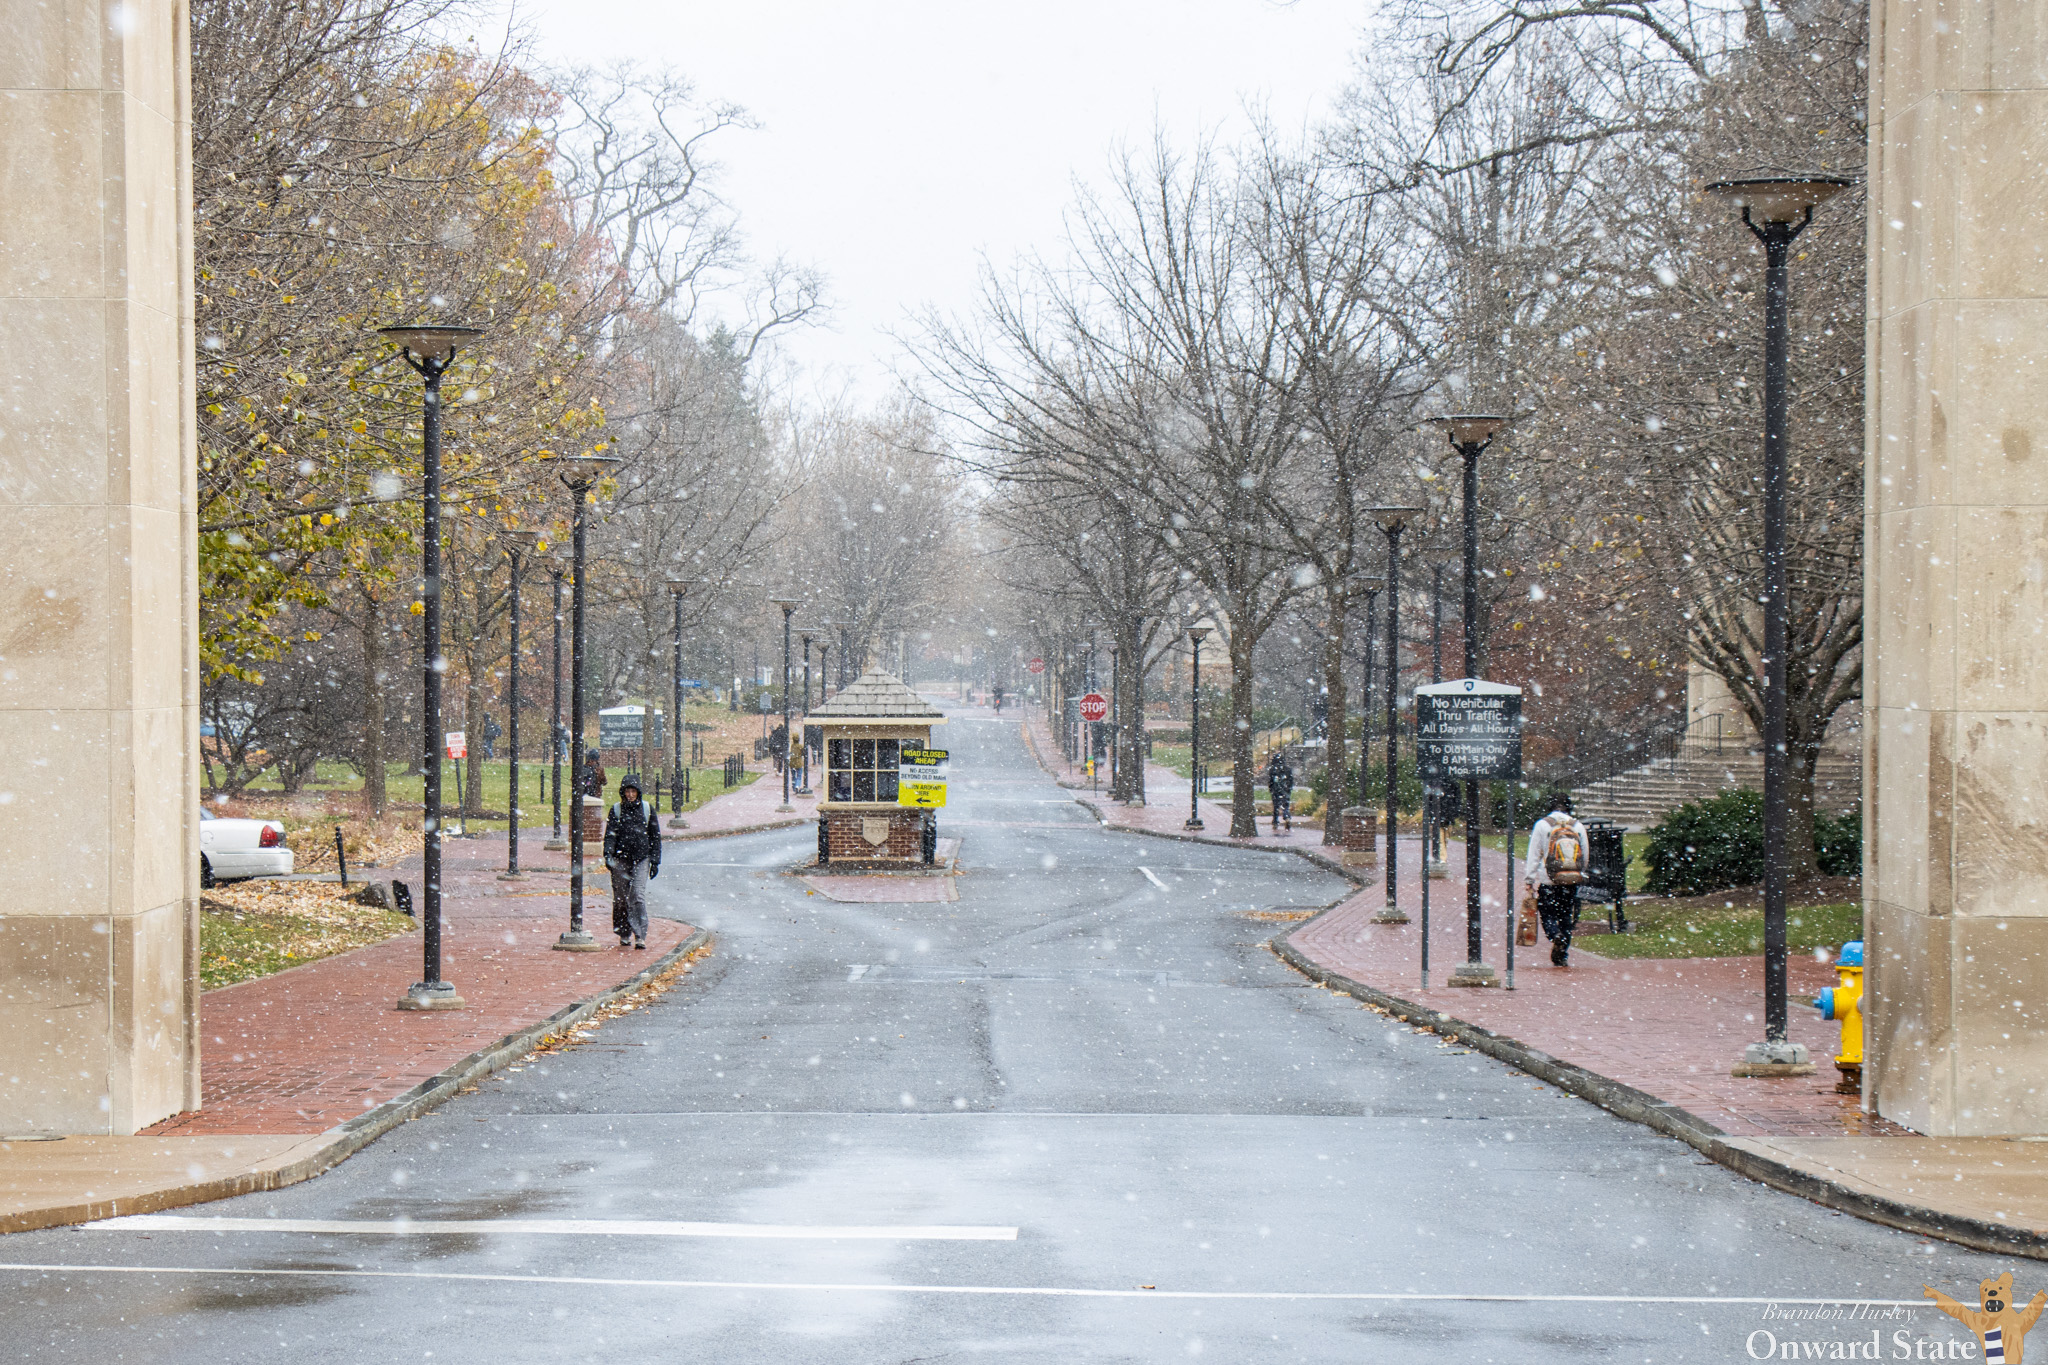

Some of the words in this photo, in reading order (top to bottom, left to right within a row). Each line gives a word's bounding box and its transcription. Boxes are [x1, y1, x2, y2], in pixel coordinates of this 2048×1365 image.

[1081, 701, 1106, 713] STOP
[1432, 698, 1449, 709] No
[1453, 698, 1505, 709] Vehicular
[1437, 710, 1461, 720] Thru
[1466, 709, 1502, 720] Traffic
[1422, 724, 1436, 733] All
[1440, 724, 1464, 735] Days
[1470, 724, 1484, 733] All
[1487, 724, 1516, 733] Hours
[1430, 745, 1441, 754] To
[1444, 745, 1460, 754] Old
[1462, 745, 1484, 754] Main
[1487, 745, 1508, 755] Only
[1442, 755, 1449, 764] 8
[1451, 755, 1467, 764] AM
[1481, 755, 1497, 764] PM
